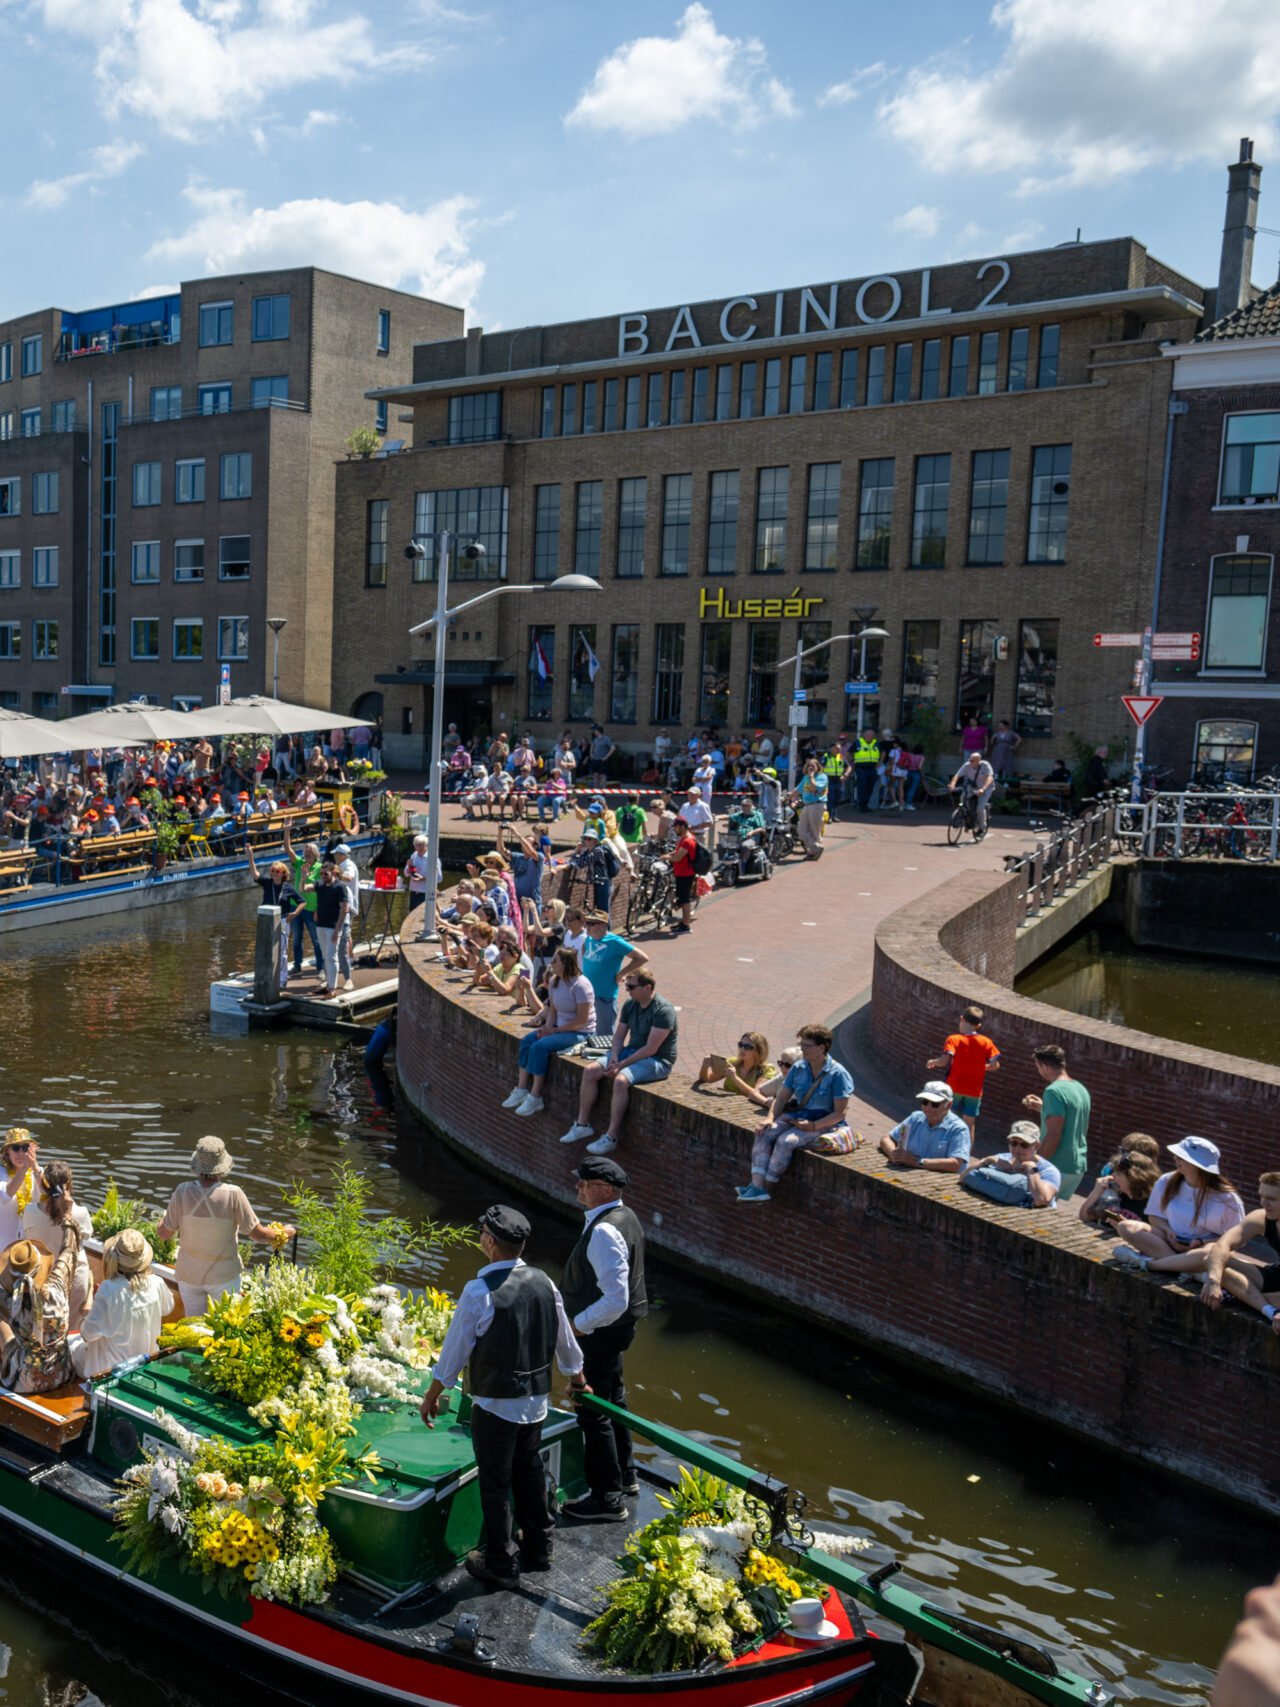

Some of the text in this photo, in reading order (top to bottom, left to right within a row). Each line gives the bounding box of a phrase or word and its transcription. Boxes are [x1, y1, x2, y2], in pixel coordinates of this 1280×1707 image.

[617, 259, 1012, 358] BACINOL 2
[699, 586, 824, 619] Huszár
